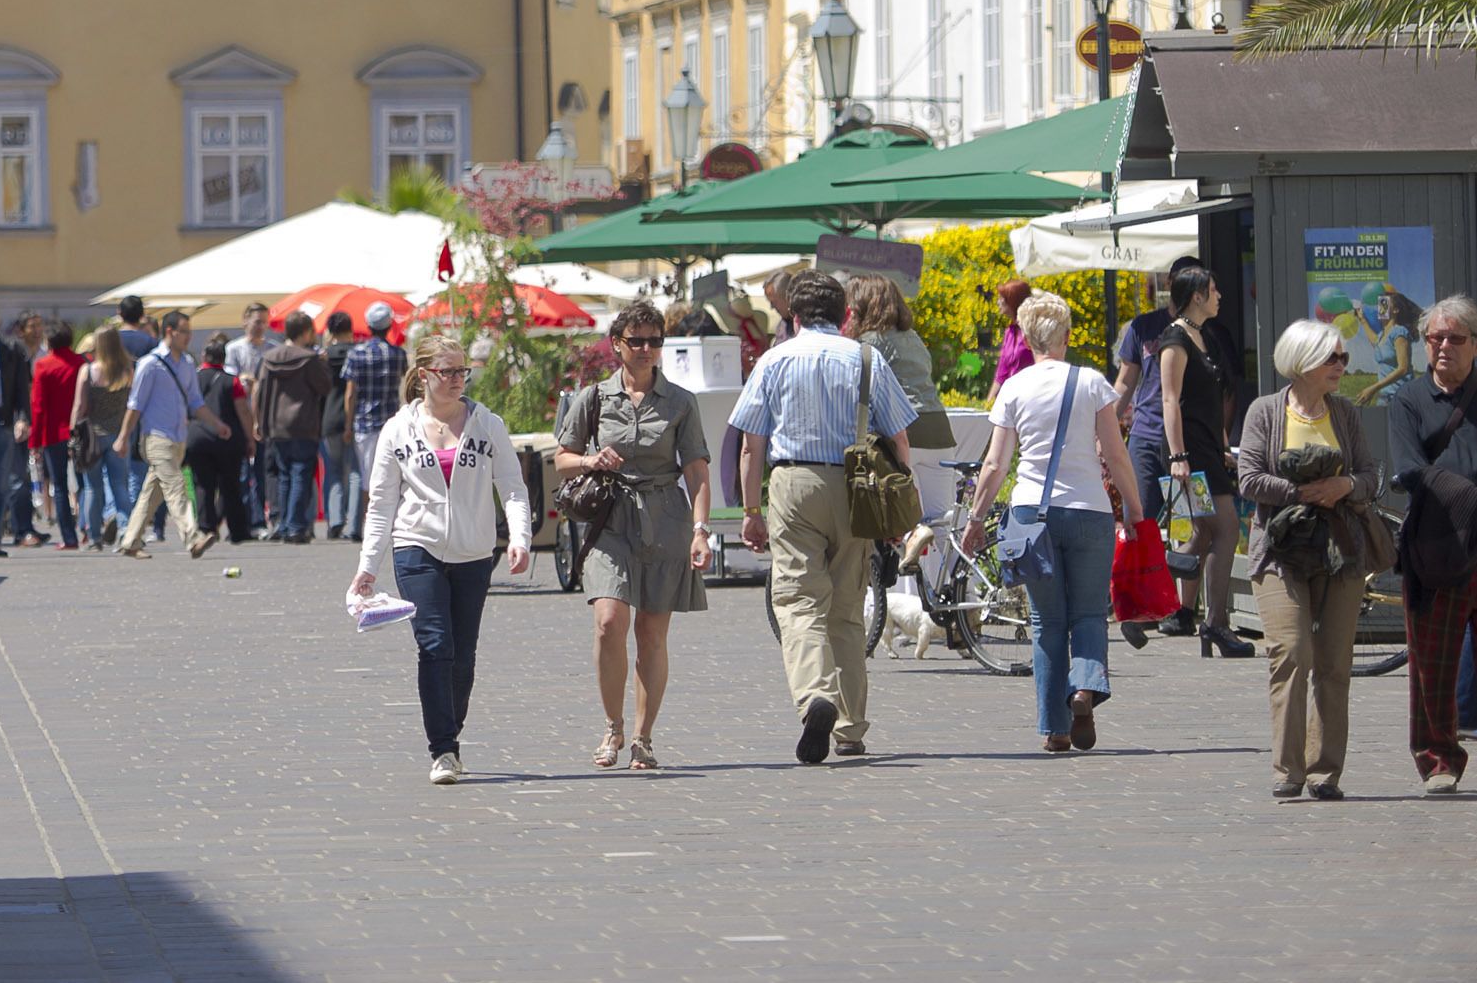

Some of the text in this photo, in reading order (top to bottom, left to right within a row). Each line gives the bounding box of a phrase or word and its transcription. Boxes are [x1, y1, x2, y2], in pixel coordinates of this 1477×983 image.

[1314, 245, 1384, 257] FIT IN DEN
[1315, 255, 1384, 269] FRÜHLING
[419, 452, 477, 468] 18 93
